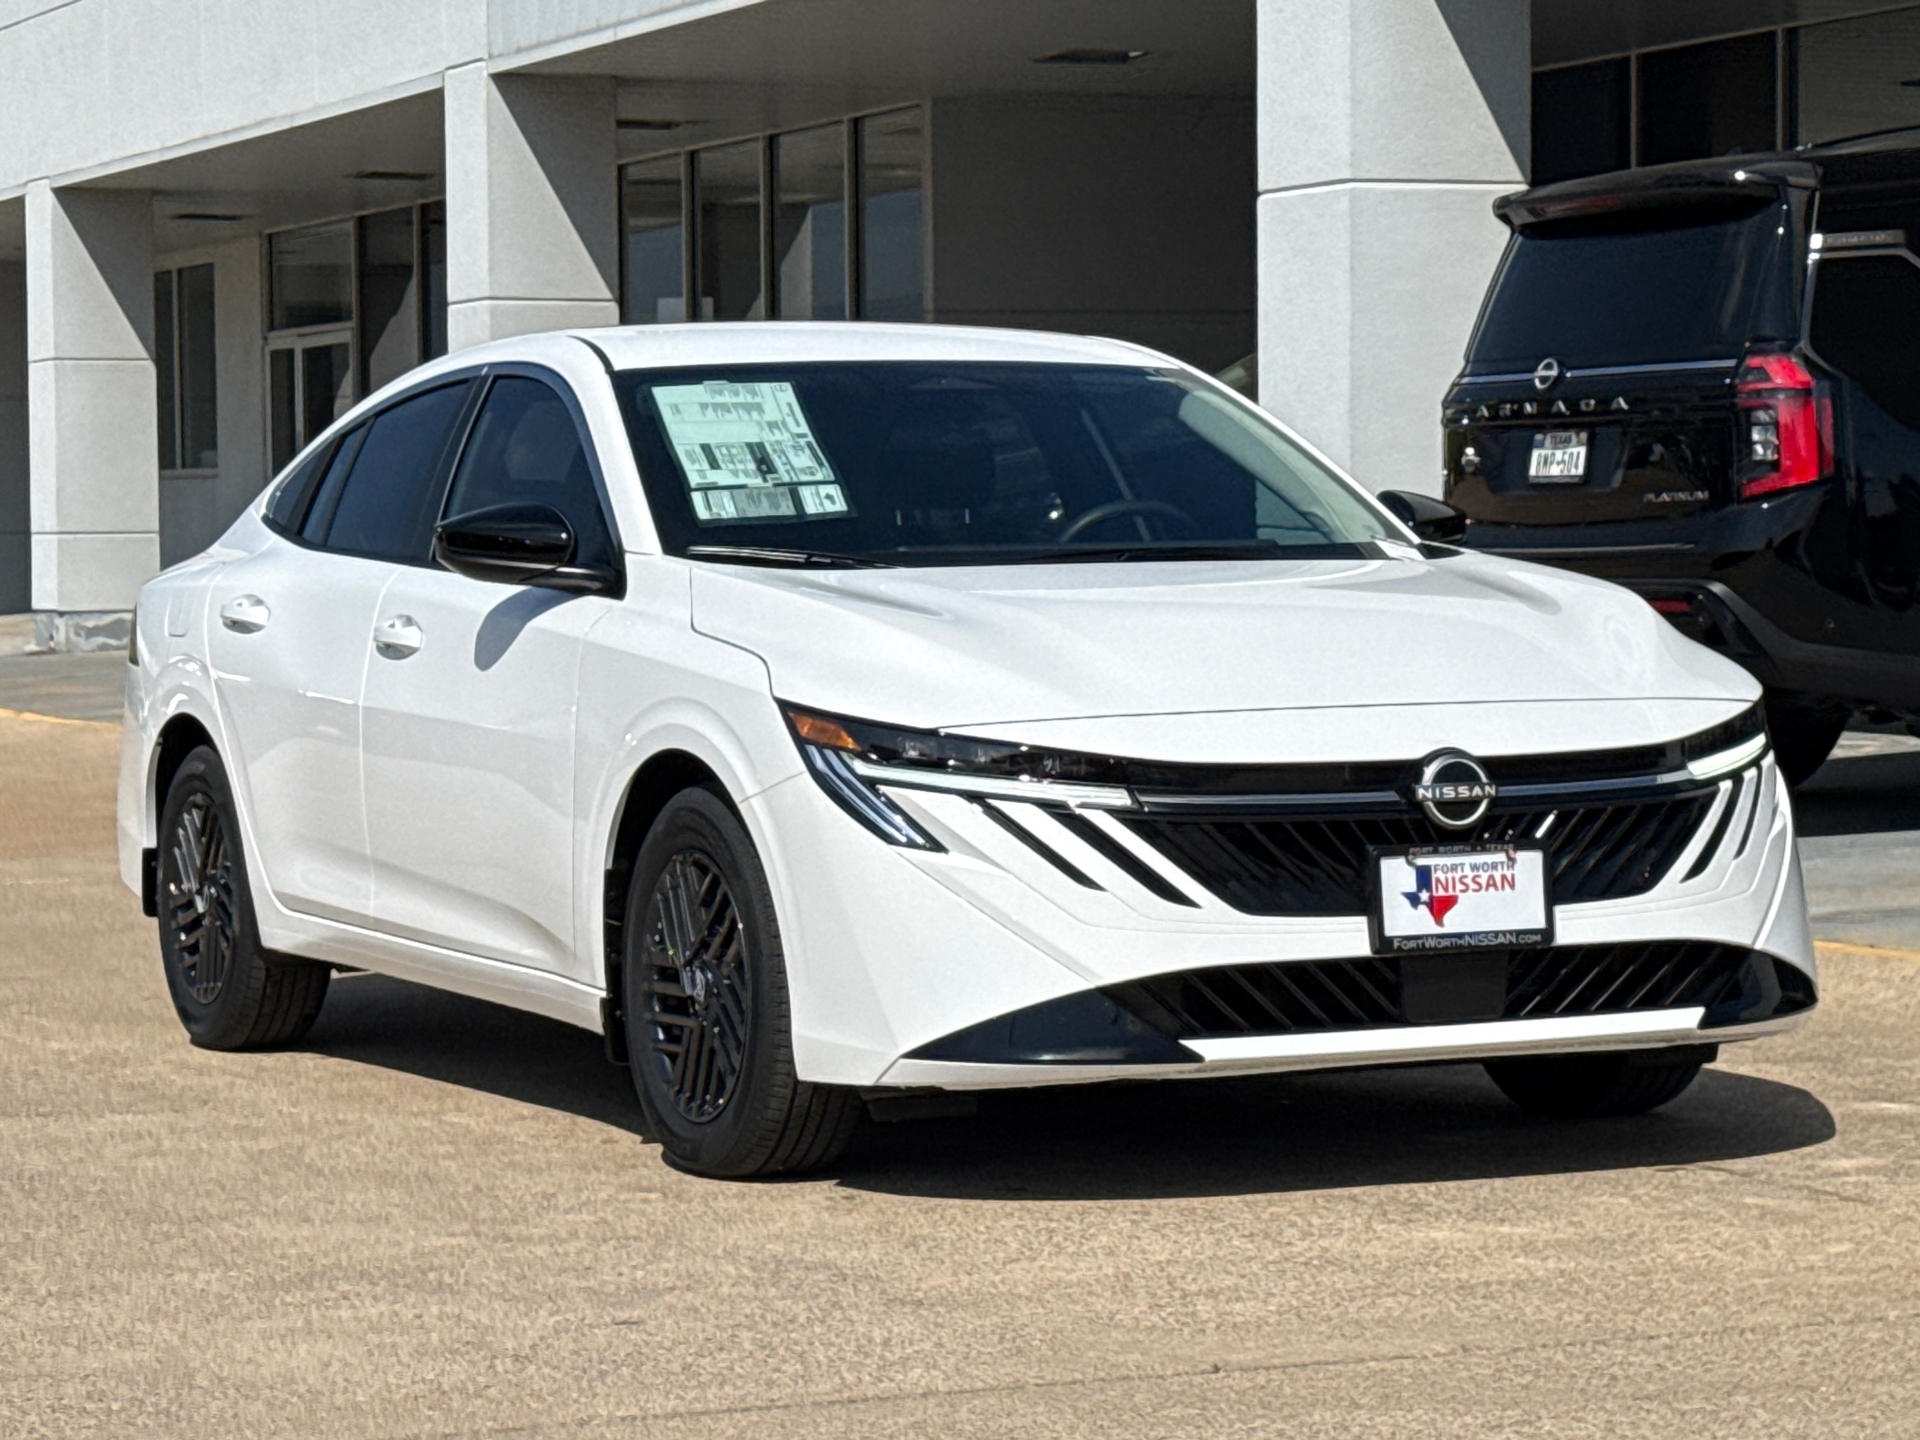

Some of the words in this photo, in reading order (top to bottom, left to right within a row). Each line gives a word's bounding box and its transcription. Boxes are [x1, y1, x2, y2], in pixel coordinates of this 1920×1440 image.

[1417, 784, 1497, 799] NISSAN
[1438, 845, 1472, 853] WORTH
[1433, 863, 1466, 875] FORT
[1469, 861, 1516, 873] WORTH
[1434, 873, 1516, 894] NISSAN
